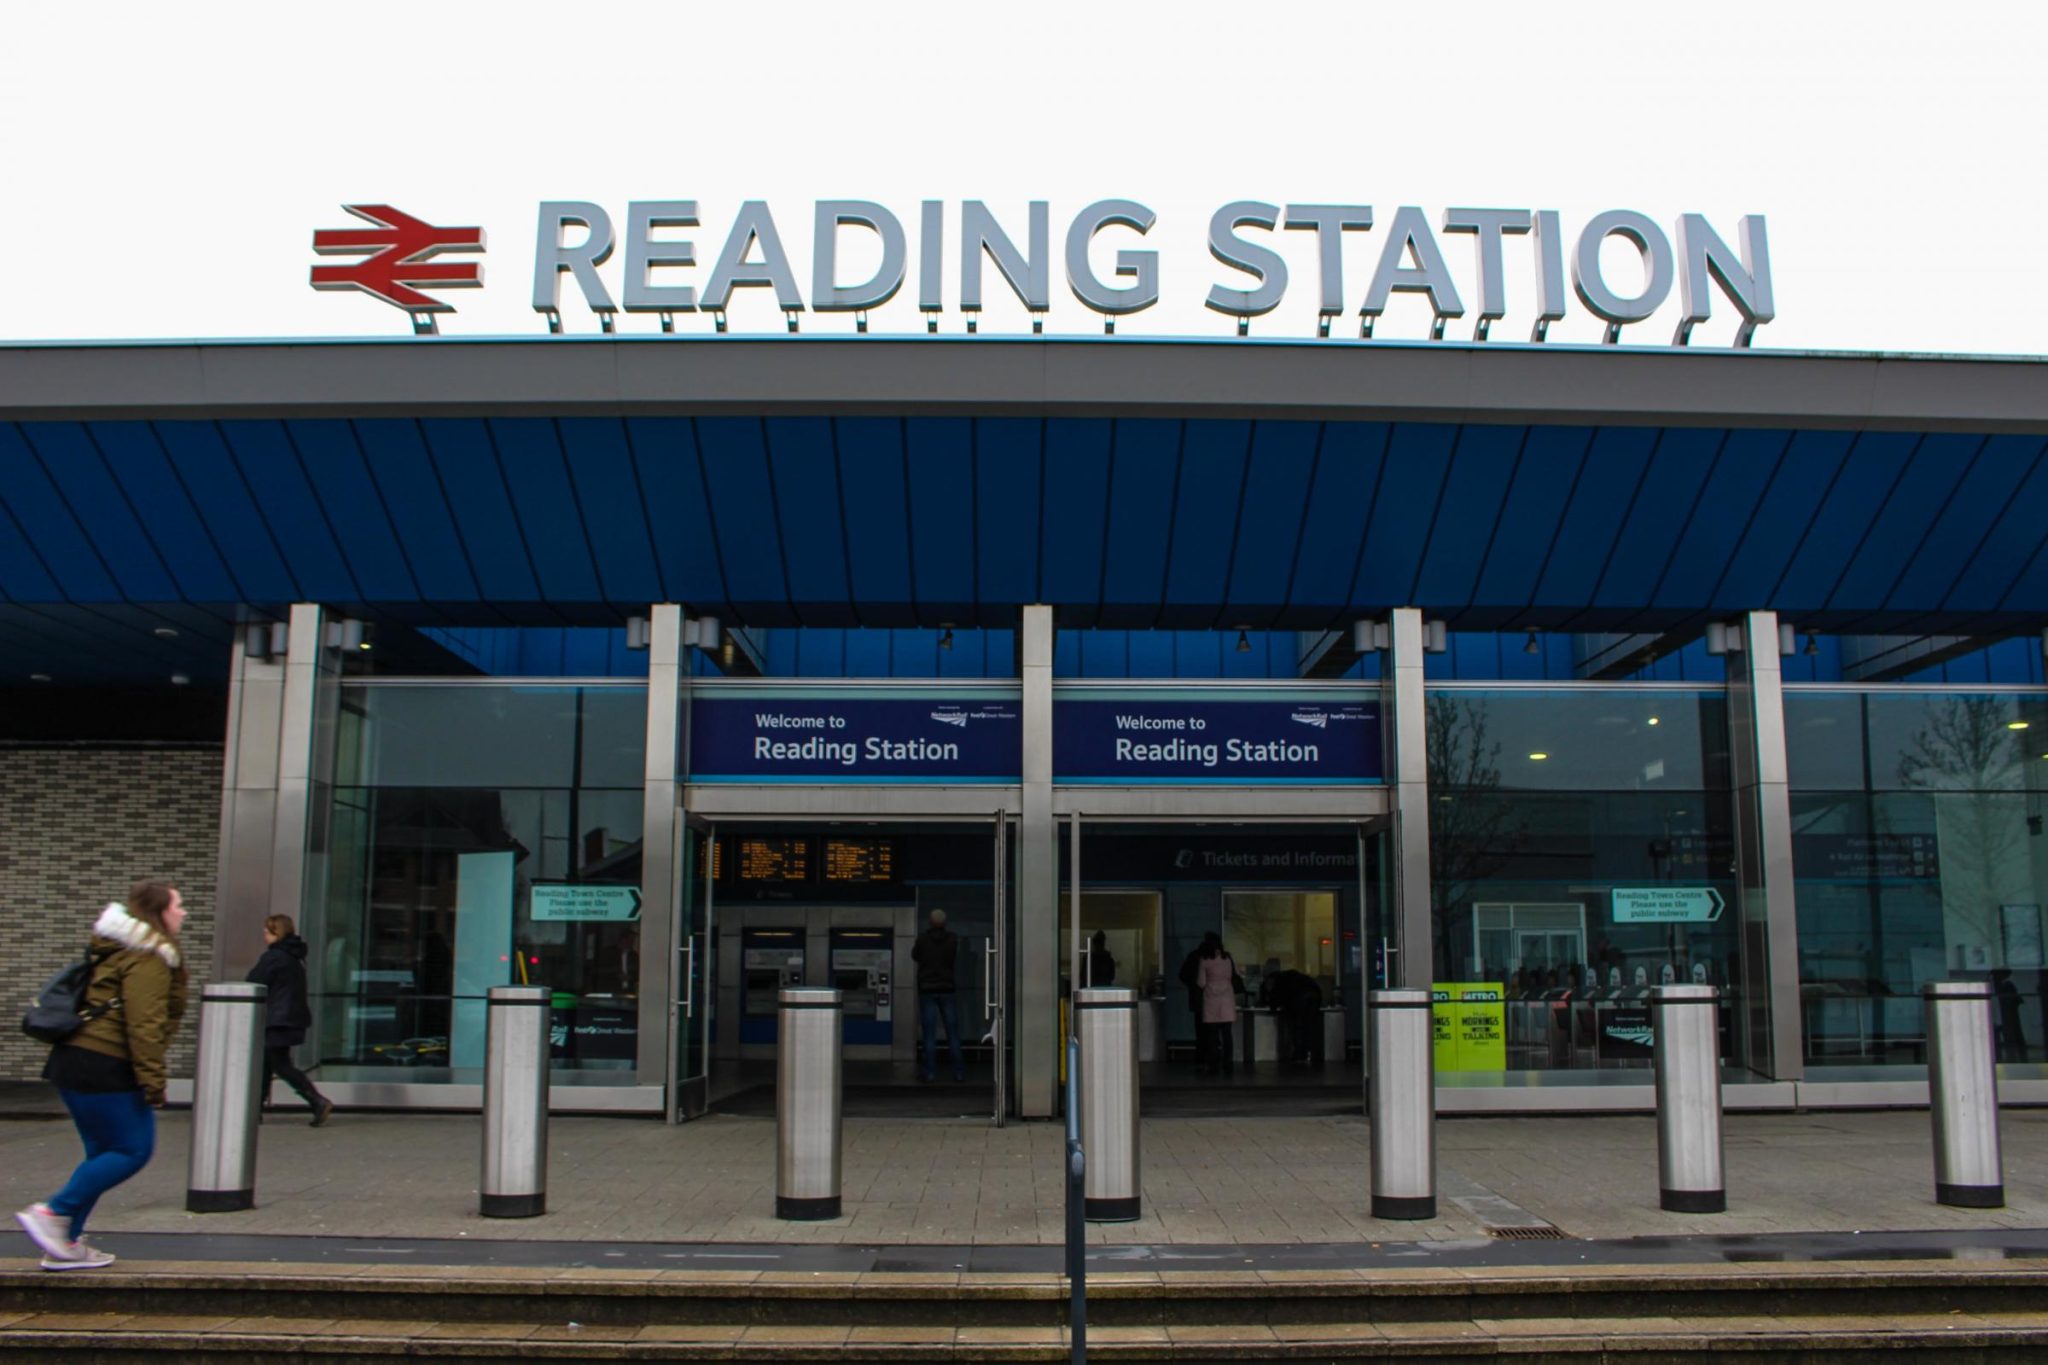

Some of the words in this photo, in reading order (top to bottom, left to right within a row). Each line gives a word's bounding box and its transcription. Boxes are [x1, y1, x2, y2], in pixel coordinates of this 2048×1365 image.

[532, 198, 1160, 315] READING
[1204, 200, 1775, 324] STATION
[755, 714, 825, 728] Welcome
[830, 716, 846, 728] to
[1116, 715, 1186, 730] Welcome
[1190, 717, 1206, 730] to
[755, 736, 857, 765] Reading
[865, 737, 959, 760] Station
[1116, 738, 1218, 767] Reading
[1226, 739, 1319, 762] Station
[1203, 851, 1257, 866] Tickets
[1262, 851, 1290, 866] and
[1616, 891, 1648, 900] Reading
[1650, 891, 1674, 899] Town
[1675, 891, 1703, 899] Centre
[1631, 900, 1656, 908] Please
[1674, 900, 1688, 908] the
[1630, 910, 1655, 918] public
[1657, 910, 1689, 918] subway
